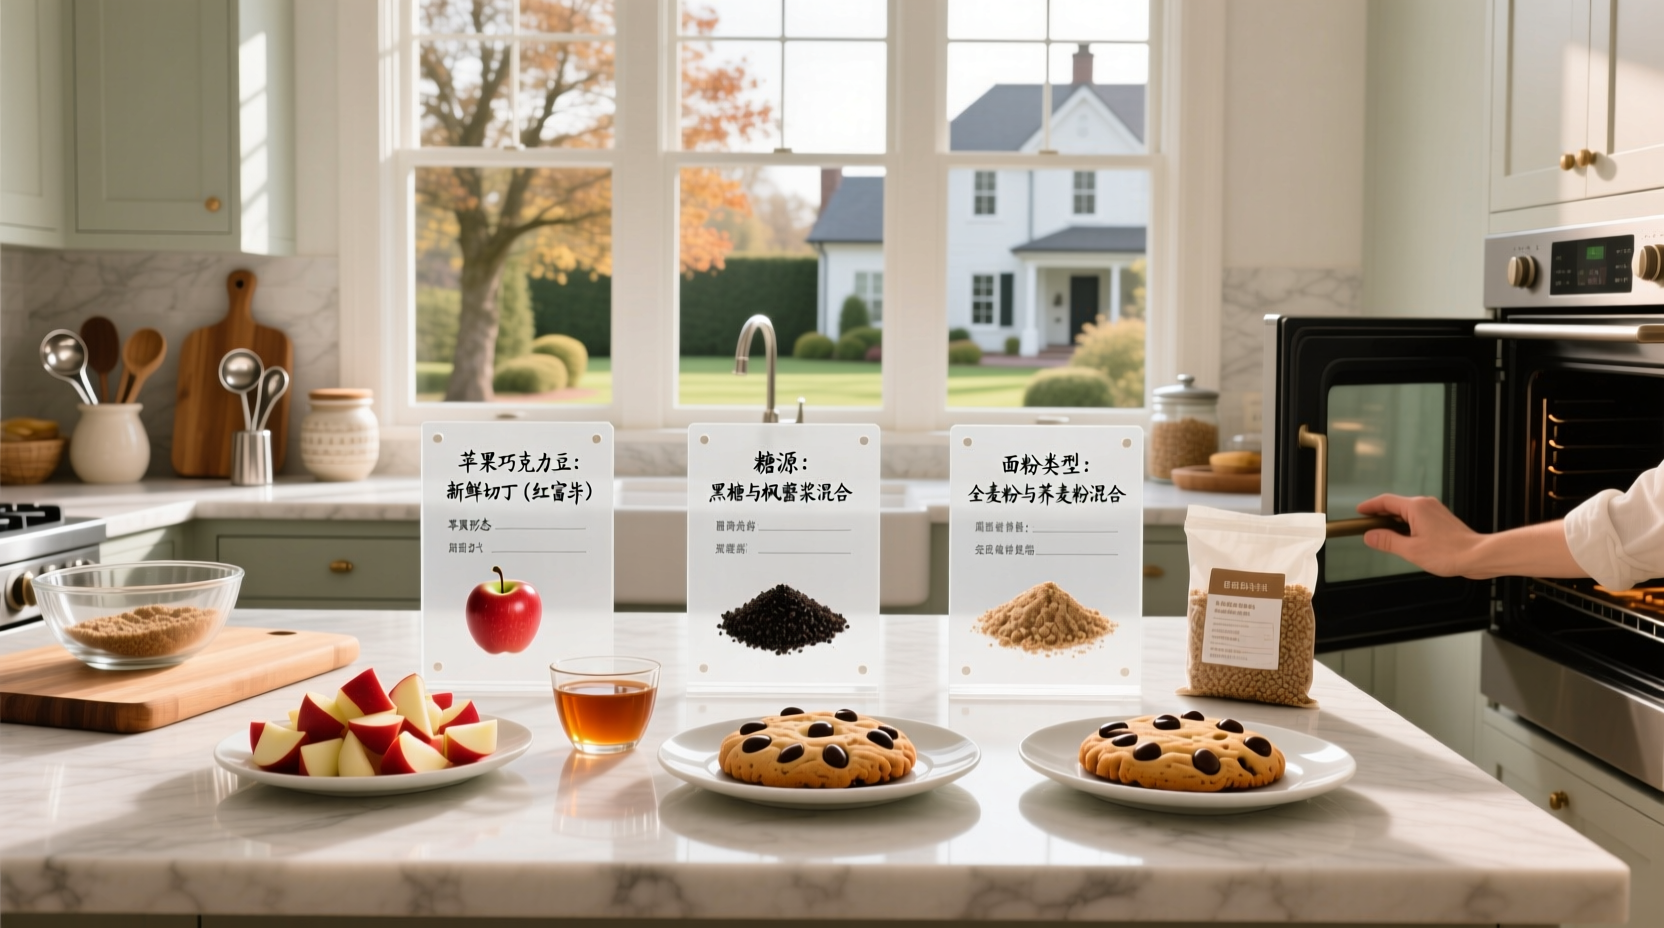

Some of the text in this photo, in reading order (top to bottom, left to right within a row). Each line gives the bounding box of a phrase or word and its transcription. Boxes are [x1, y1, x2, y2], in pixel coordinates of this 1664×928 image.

[753, 450, 808, 474] 糖源：
[1002, 452, 1090, 476] 面粉类型：
